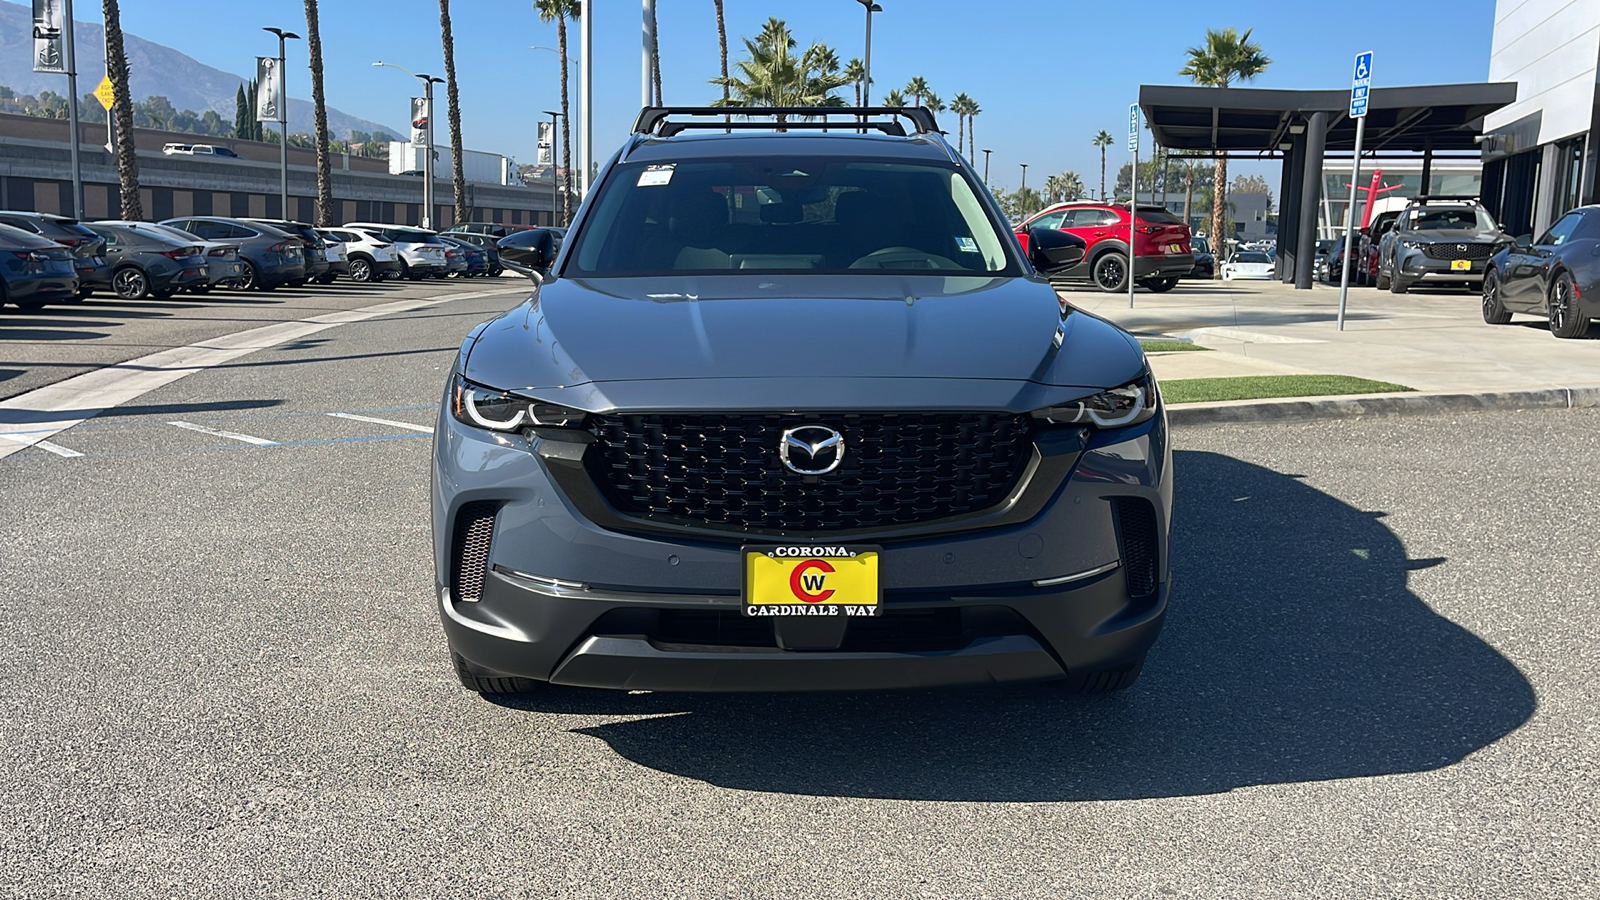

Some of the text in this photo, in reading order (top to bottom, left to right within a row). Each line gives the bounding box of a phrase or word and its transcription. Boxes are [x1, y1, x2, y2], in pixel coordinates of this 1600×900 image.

[775, 546, 849, 557] CORONA
[747, 605, 877, 616] CARDINALE WAY
